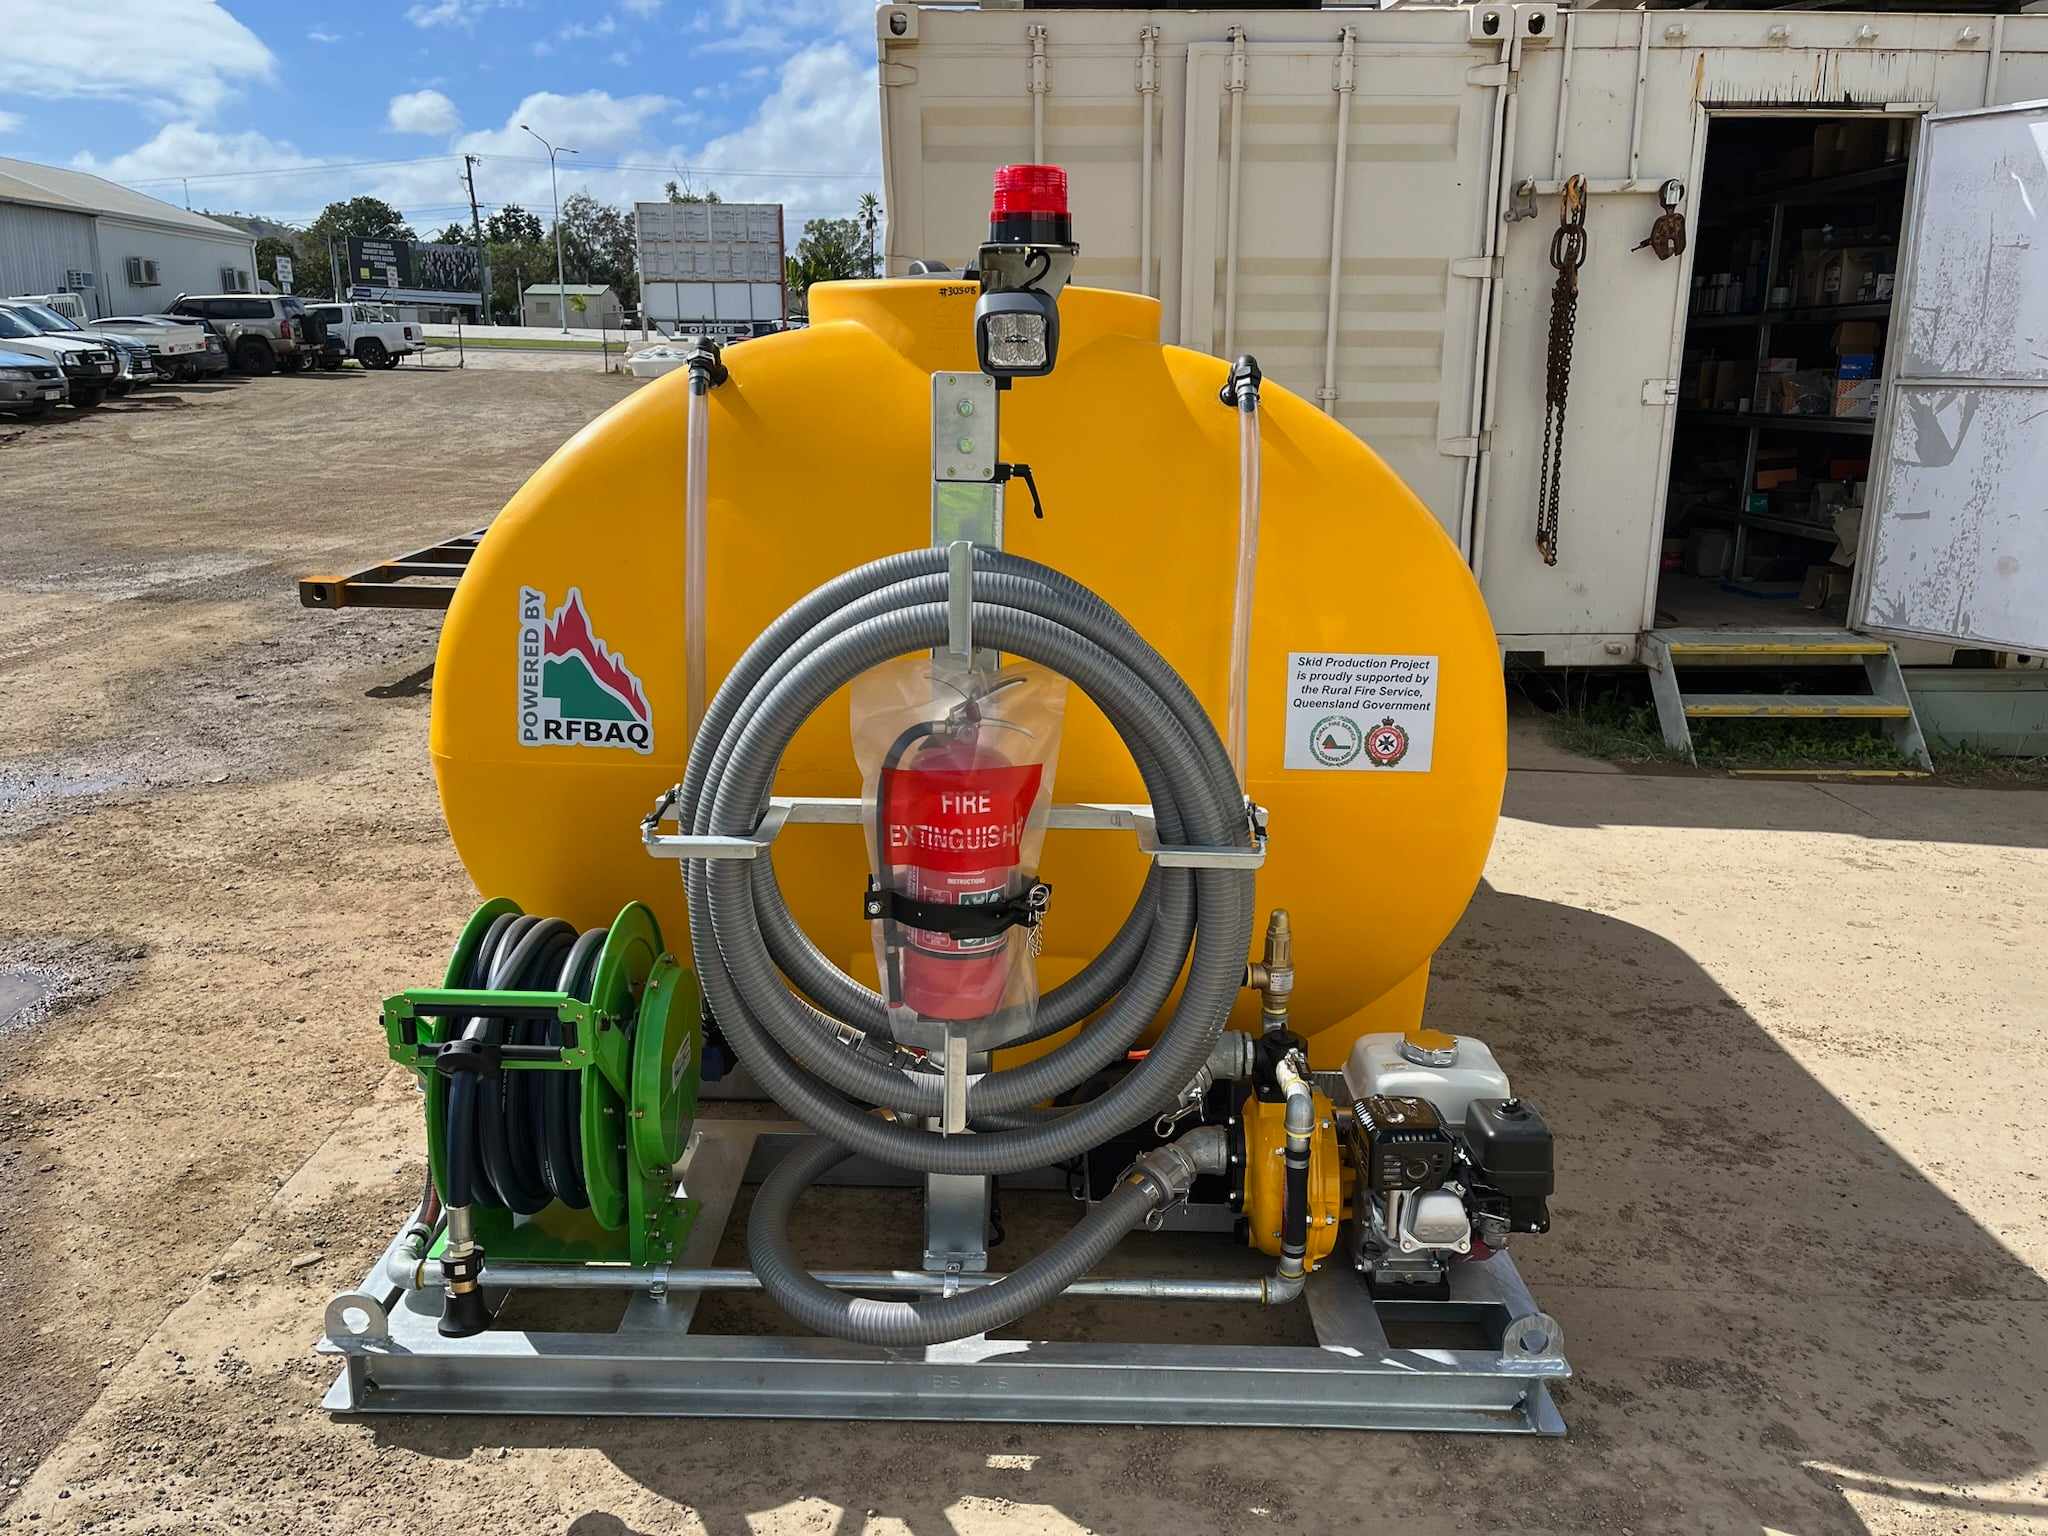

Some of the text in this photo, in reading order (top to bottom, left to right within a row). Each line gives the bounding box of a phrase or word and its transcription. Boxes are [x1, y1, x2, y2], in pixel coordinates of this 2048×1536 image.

[689, 325, 735, 334] OFFICE
[523, 591, 540, 741] POWERED BY
[1298, 657, 1430, 671] Skid Production Project
[1297, 671, 1429, 685] is proudly supported by
[1301, 685, 1423, 698] the Rural Fire Service,
[1293, 698, 1431, 711] Queensland Government
[544, 719, 649, 749] RFBAQ
[941, 790, 992, 815] FIRE
